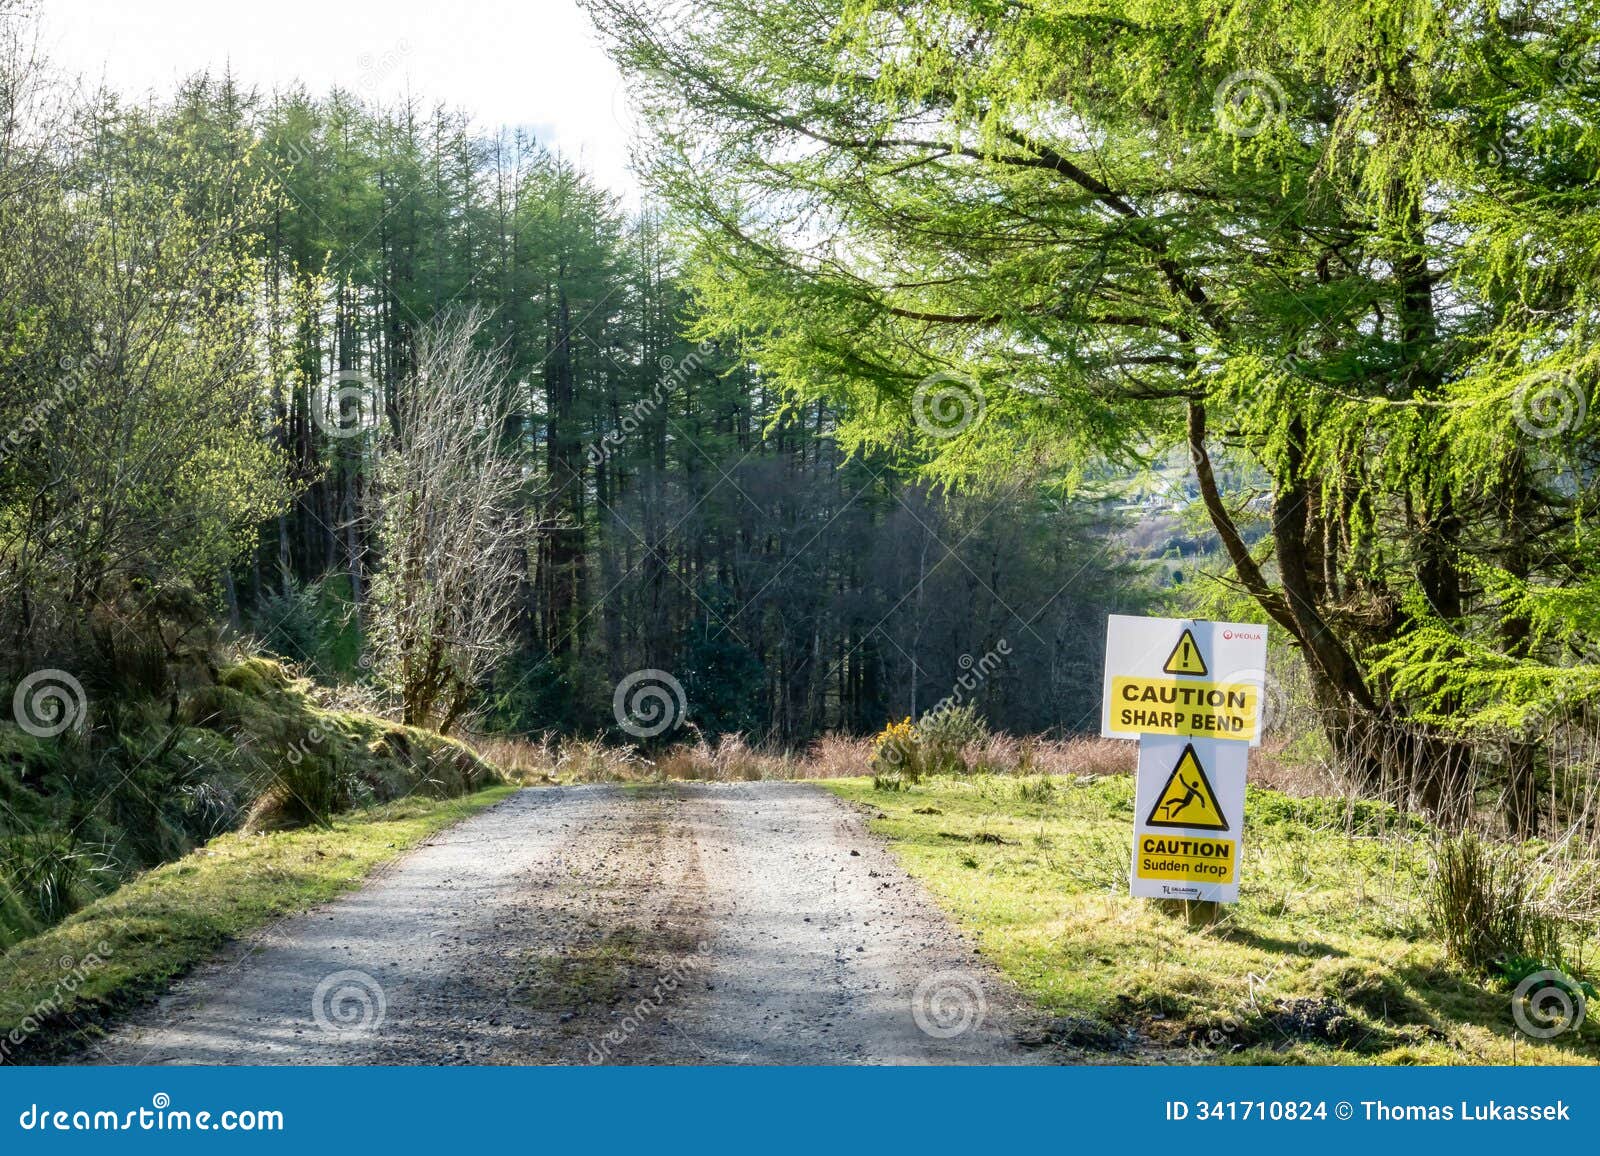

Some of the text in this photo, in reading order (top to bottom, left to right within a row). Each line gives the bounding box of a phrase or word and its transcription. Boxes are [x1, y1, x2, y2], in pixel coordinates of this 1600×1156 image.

[1234, 632, 1262, 640] VEOLIA
[1122, 684, 1246, 709] CAUTION
[1121, 709, 1244, 732] SHARP BEND
[1143, 839, 1229, 857] CAUTION
[1143, 859, 1227, 877] Sudden drop
